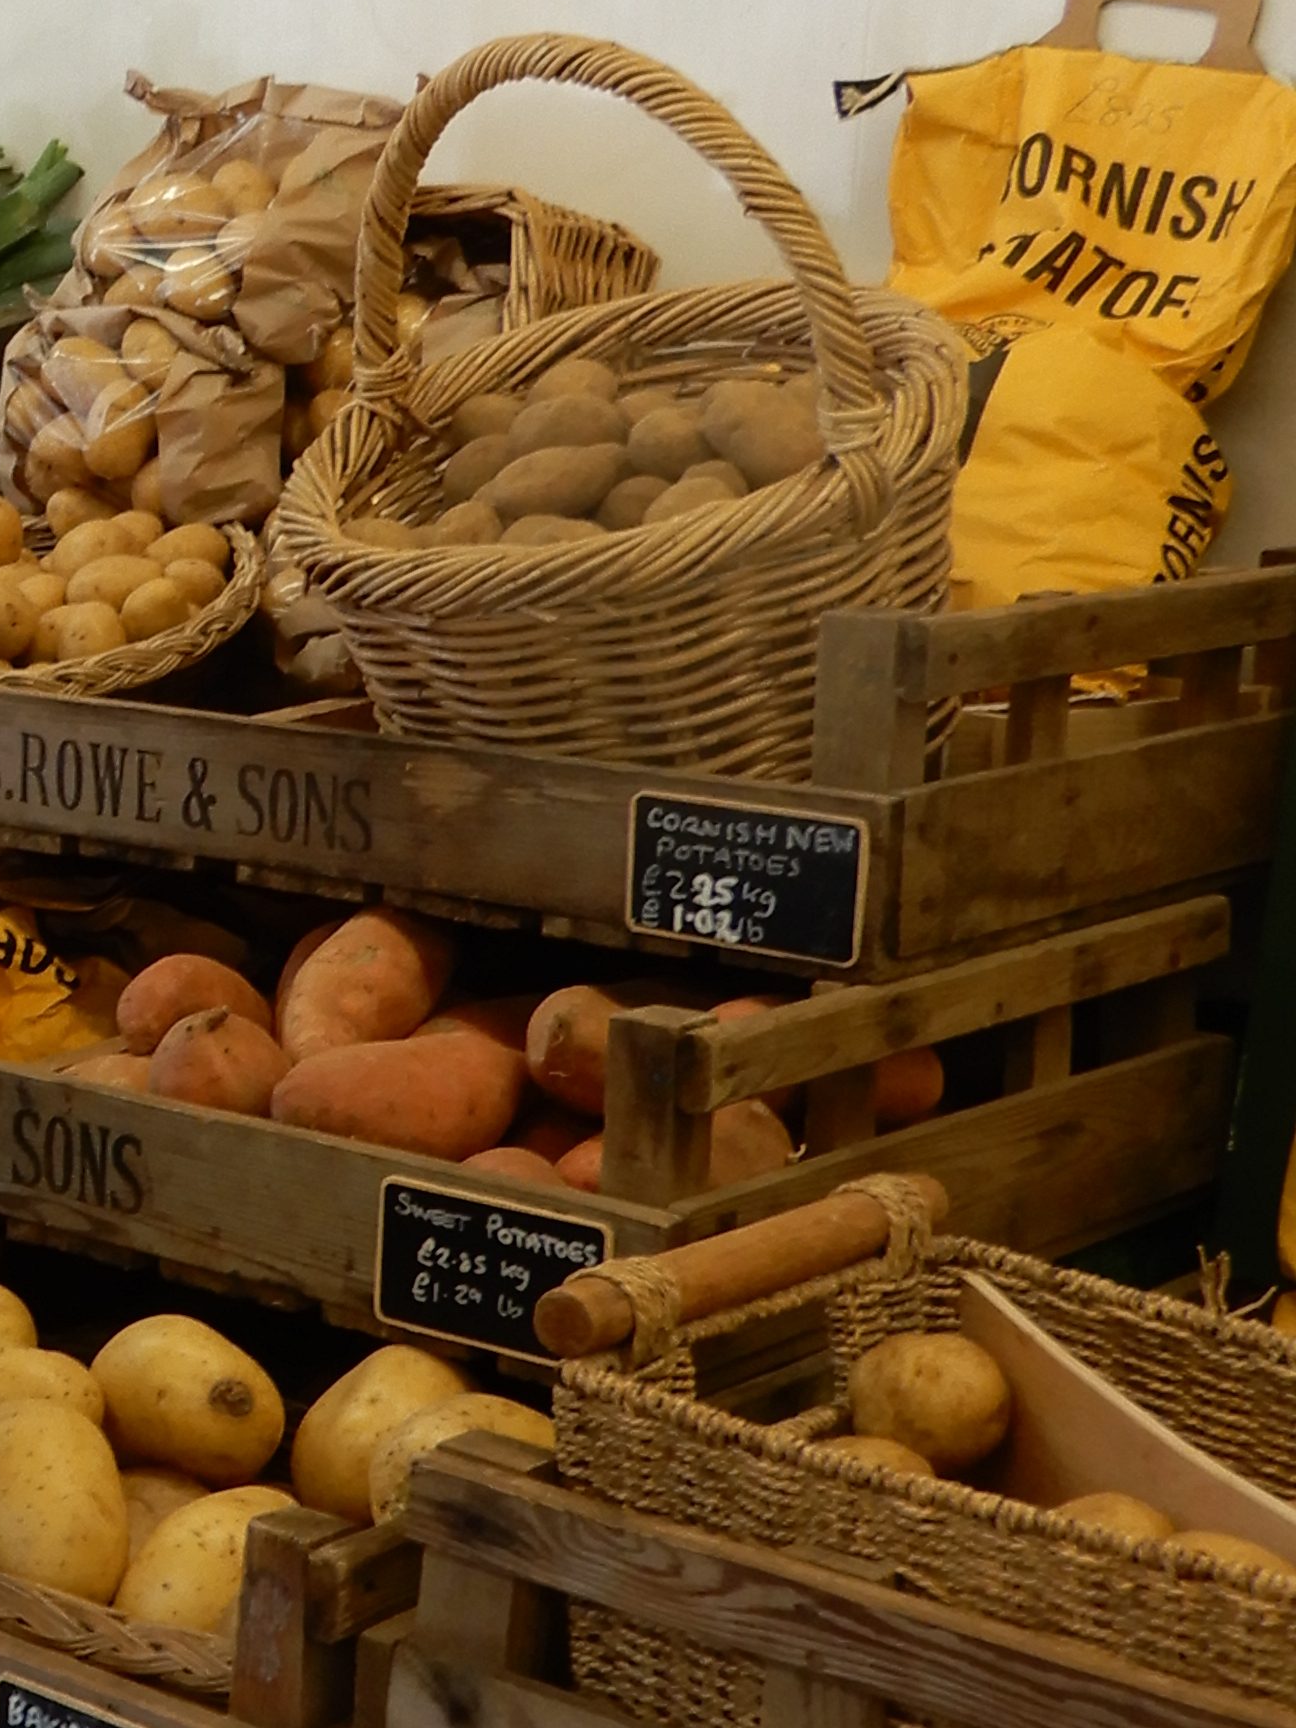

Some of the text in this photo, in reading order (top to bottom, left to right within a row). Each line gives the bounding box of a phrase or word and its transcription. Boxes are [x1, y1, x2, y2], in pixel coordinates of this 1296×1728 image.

[1000, 131, 1256, 242] ORNISH
[181, 757, 218, 833] &
[236, 763, 374, 854] SONS
[646, 807, 856, 854] CORNISH NEW
[656, 835, 801, 877] POTATOES
[11, 1106, 145, 1215] SONS
[486, 1212, 598, 1267] POTATOES
